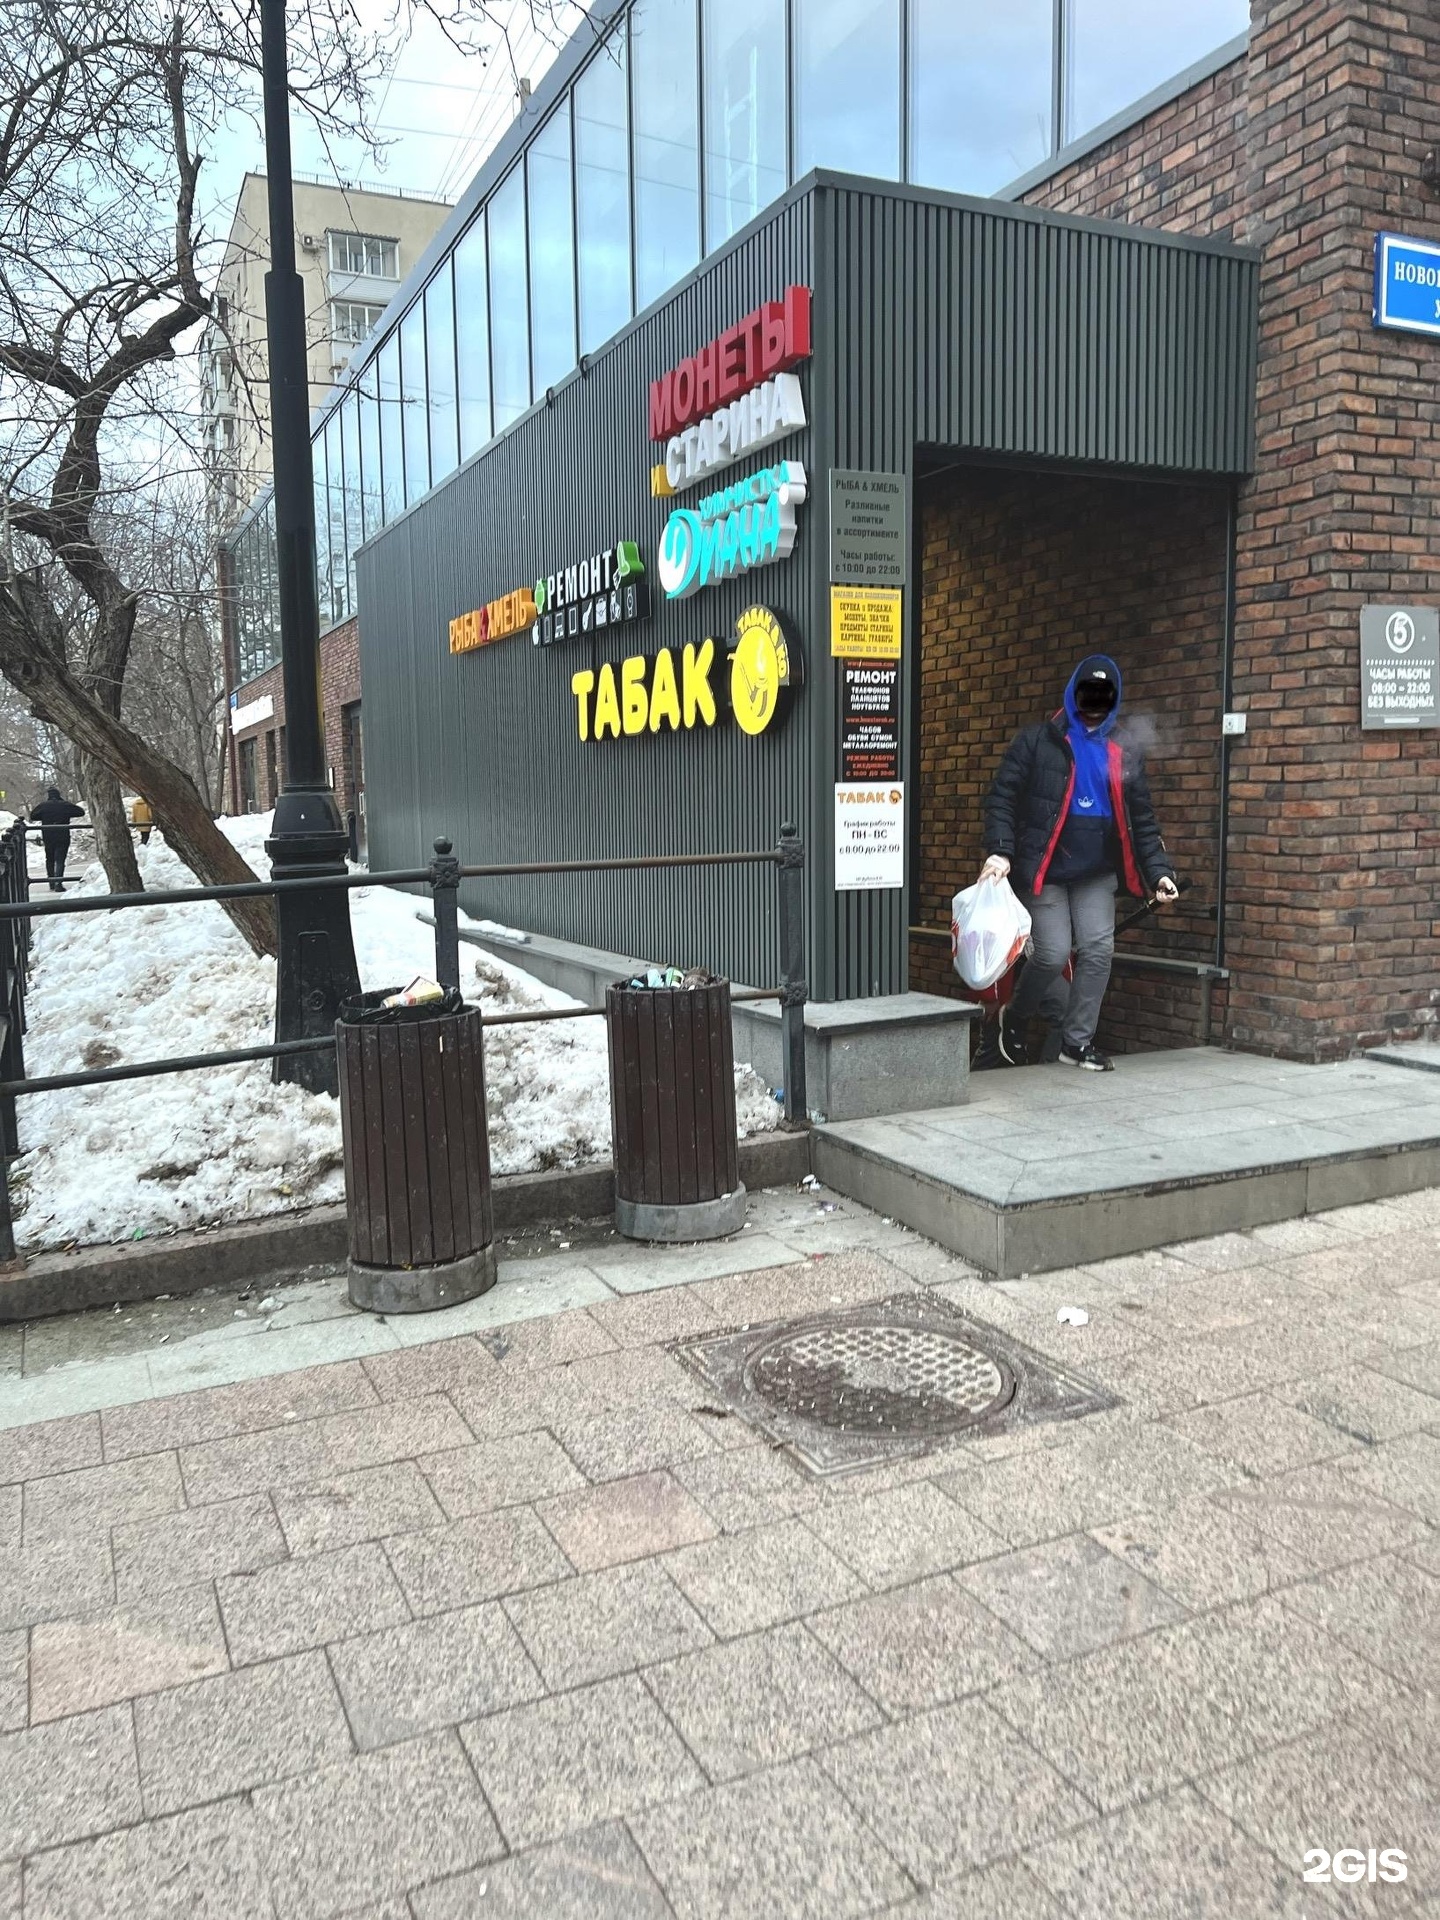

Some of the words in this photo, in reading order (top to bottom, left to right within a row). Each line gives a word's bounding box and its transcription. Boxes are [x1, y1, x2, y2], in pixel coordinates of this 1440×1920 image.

[1394, 261, 1440, 288] НОВО
[650, 285, 806, 441] МОНЕТЫ
[666, 372, 803, 487] СТАРИНА
[835, 479, 860, 491] РЫБА
[862, 481, 868, 491] &
[871, 482, 900, 494] ХМЕЛЬ
[845, 500, 890, 511] Разливные
[852, 516, 884, 525] напитки
[836, 528, 842, 536] в
[844, 528, 899, 539] ассортименте
[840, 550, 862, 560] Часы
[866, 566, 877, 575] до
[547, 549, 612, 611] РЕМОНТ
[450, 609, 480, 654] РЫБА
[486, 587, 534, 640] ХМЕЛЬ
[846, 670, 897, 684] РЕМОНТ
[1369, 668, 1396, 680] ЧАСЫ
[1396, 668, 1431, 680] РАБОТЫ
[571, 638, 717, 742] ТАБАК
[1367, 695, 1384, 708] БЕЗ
[1385, 695, 1434, 709] ВЫХОДНЫХ
[837, 791, 885, 804] ТАБАК
[851, 830, 866, 839] ПН
[873, 830, 888, 839] ВС
